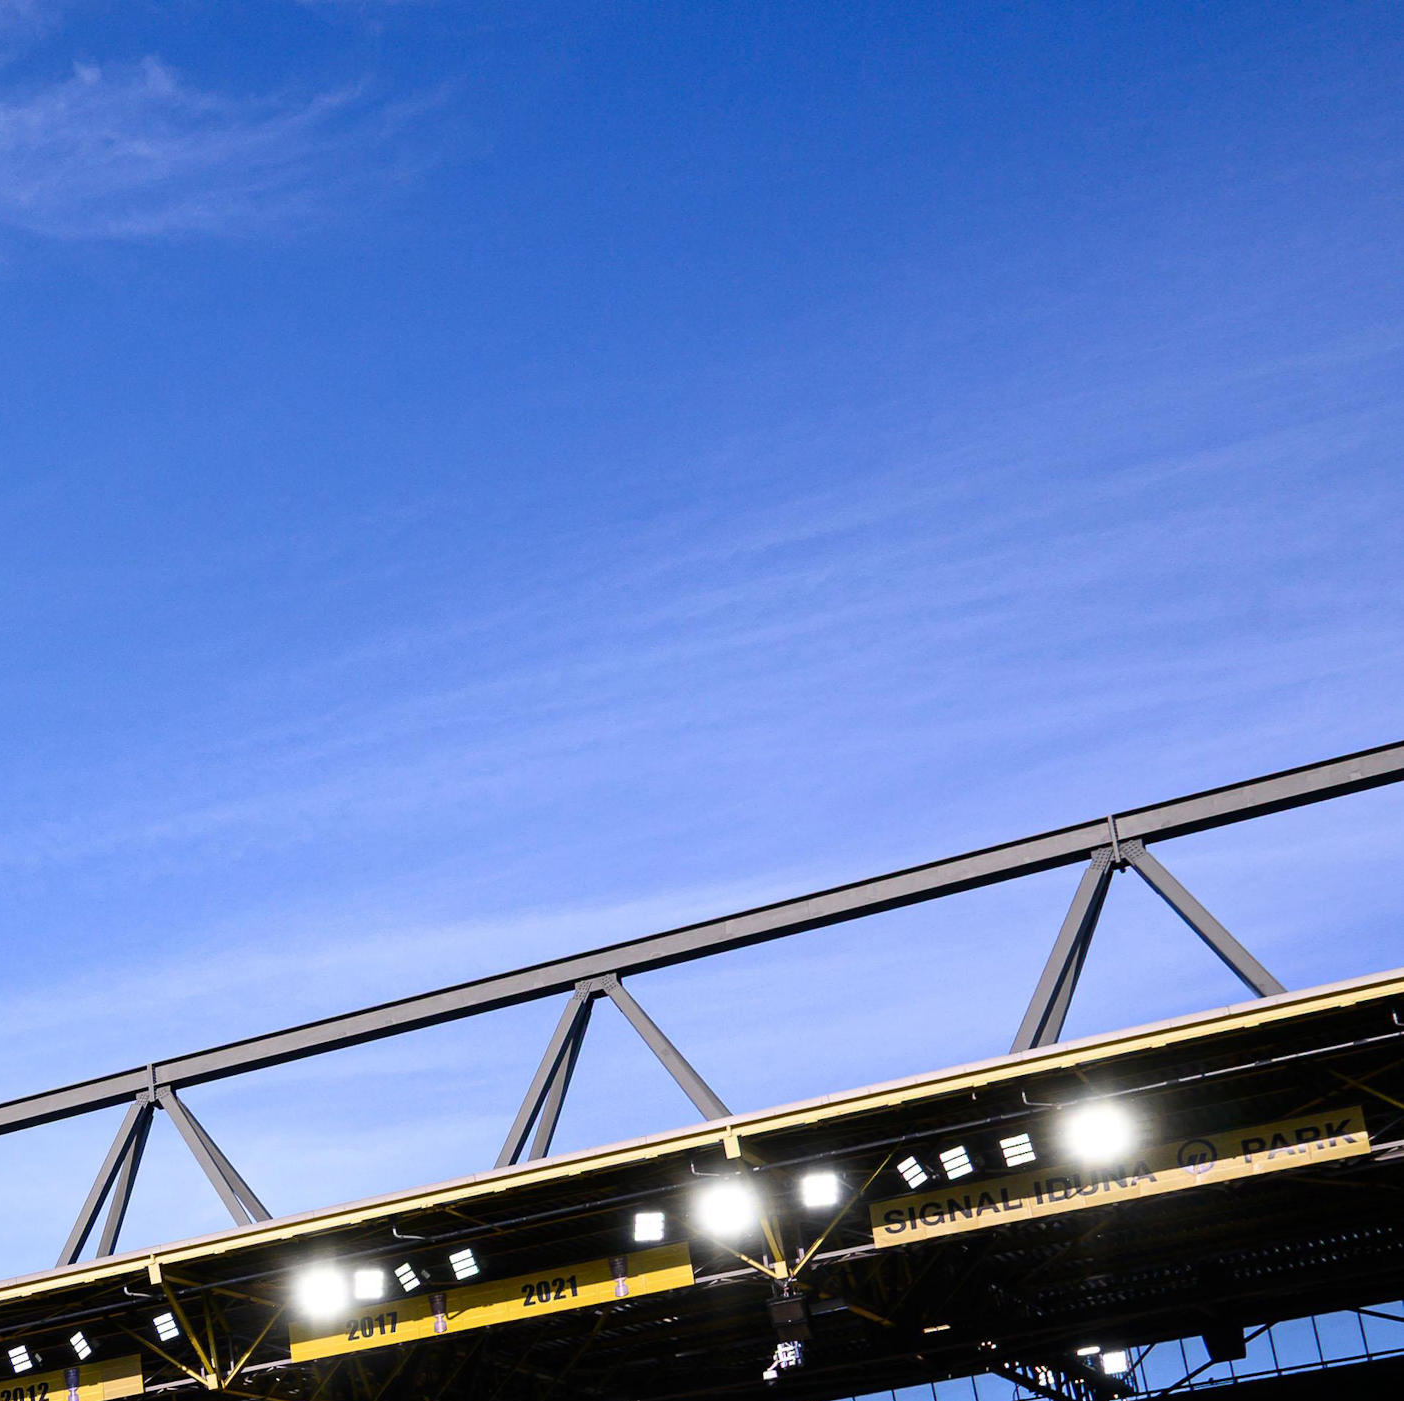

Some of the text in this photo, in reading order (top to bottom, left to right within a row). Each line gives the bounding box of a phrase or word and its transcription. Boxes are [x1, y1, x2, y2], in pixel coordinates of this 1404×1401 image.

[884, 1118, 1357, 1234] SIGNAL IDUNA PARK
[346, 1274, 578, 1341] 2017 2021
